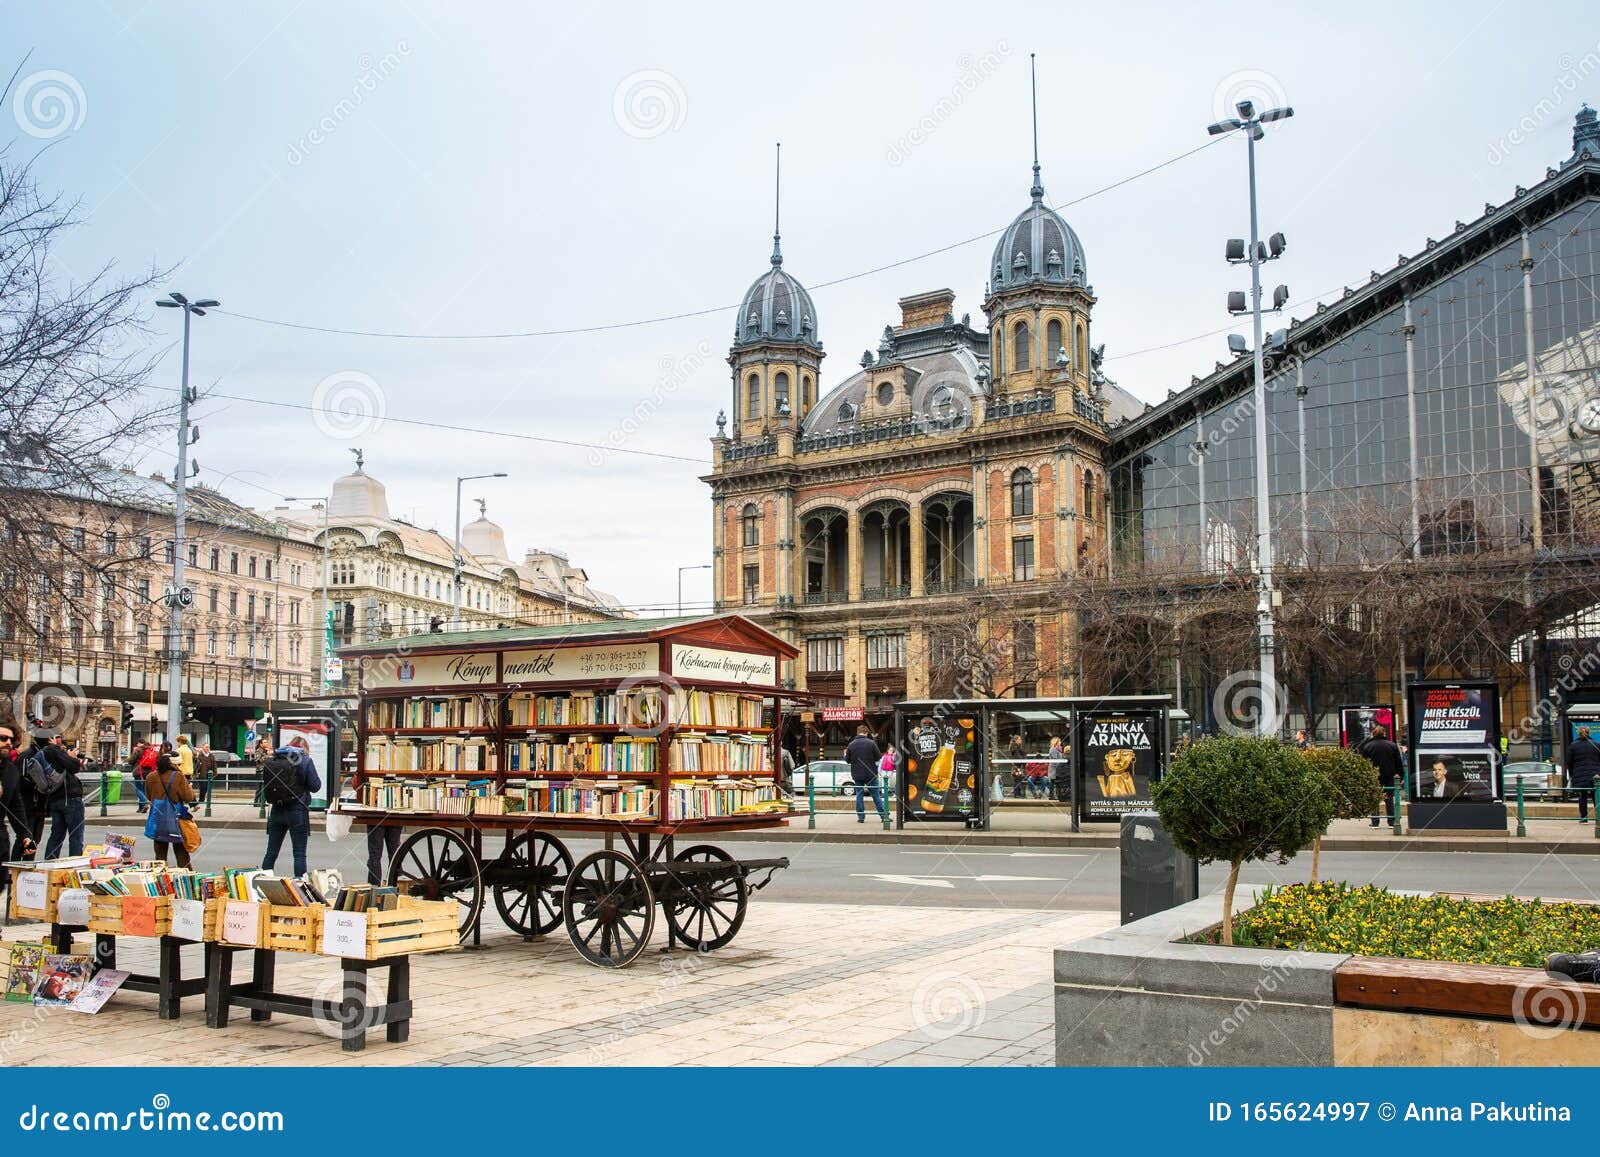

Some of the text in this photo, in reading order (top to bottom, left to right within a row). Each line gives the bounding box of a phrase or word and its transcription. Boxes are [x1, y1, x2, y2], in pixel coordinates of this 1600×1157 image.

[1424, 706, 1481, 718] MIRE KÉSZÜL
[1093, 720, 1144, 733] AZ INKÁK
[1422, 718, 1469, 729] BRÜSSZEL!
[1087, 732, 1151, 746] ARANYA
